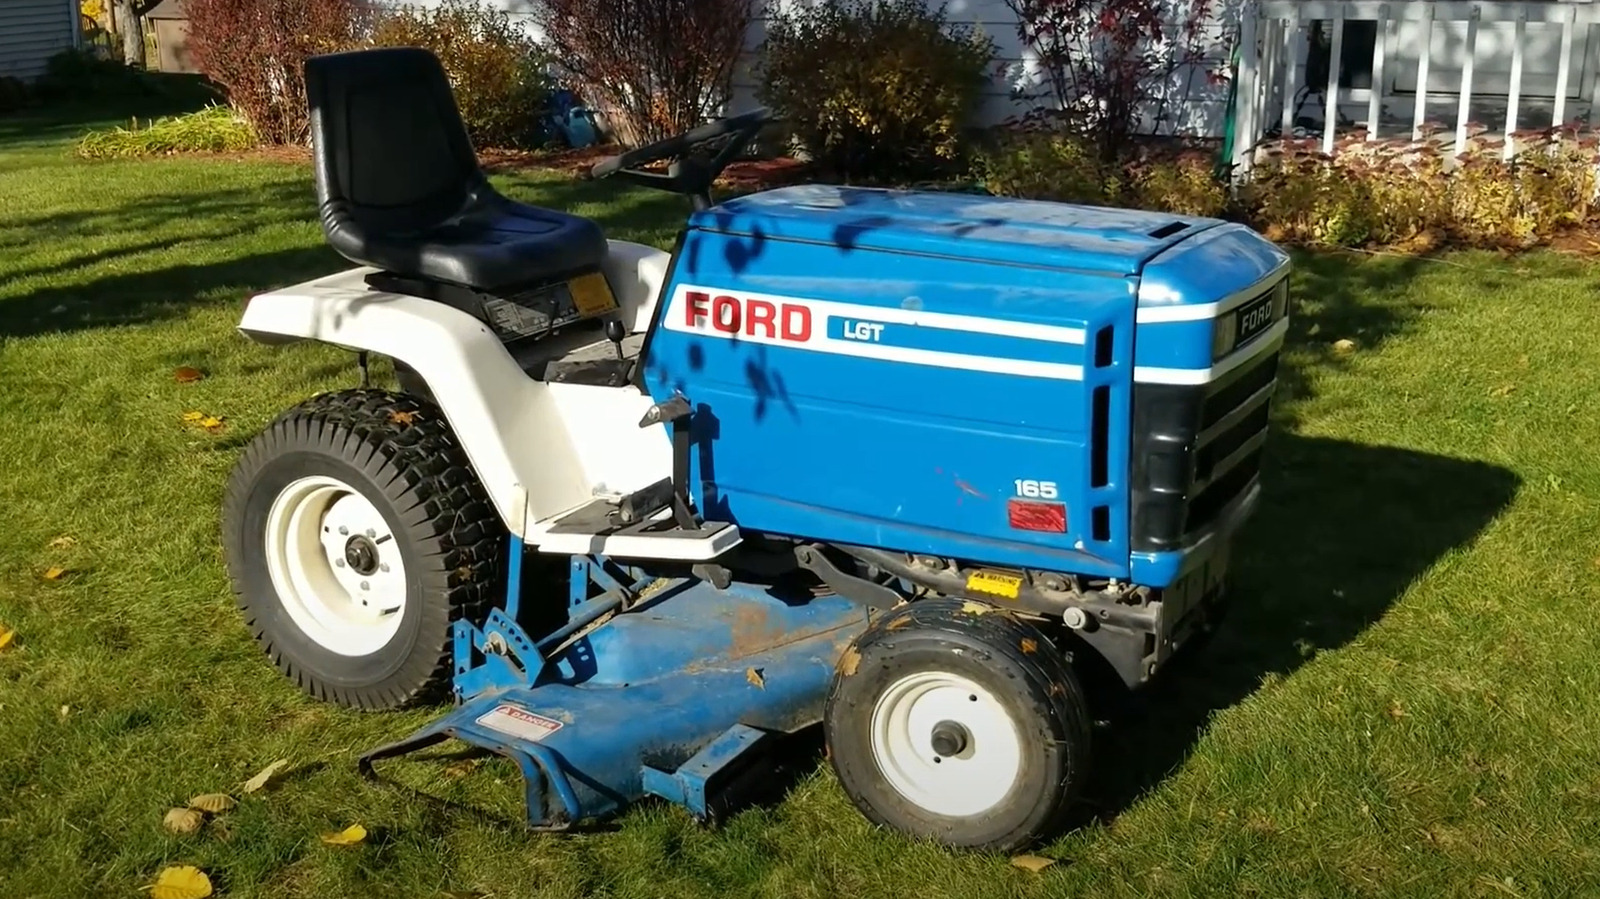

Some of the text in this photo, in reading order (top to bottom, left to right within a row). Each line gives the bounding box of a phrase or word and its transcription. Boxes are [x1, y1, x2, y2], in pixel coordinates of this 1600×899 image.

[685, 291, 885, 343] FORD LGT
[1241, 301, 1273, 336] FORD
[1014, 479, 1058, 499] 165
[511, 711, 556, 730] DANGER
